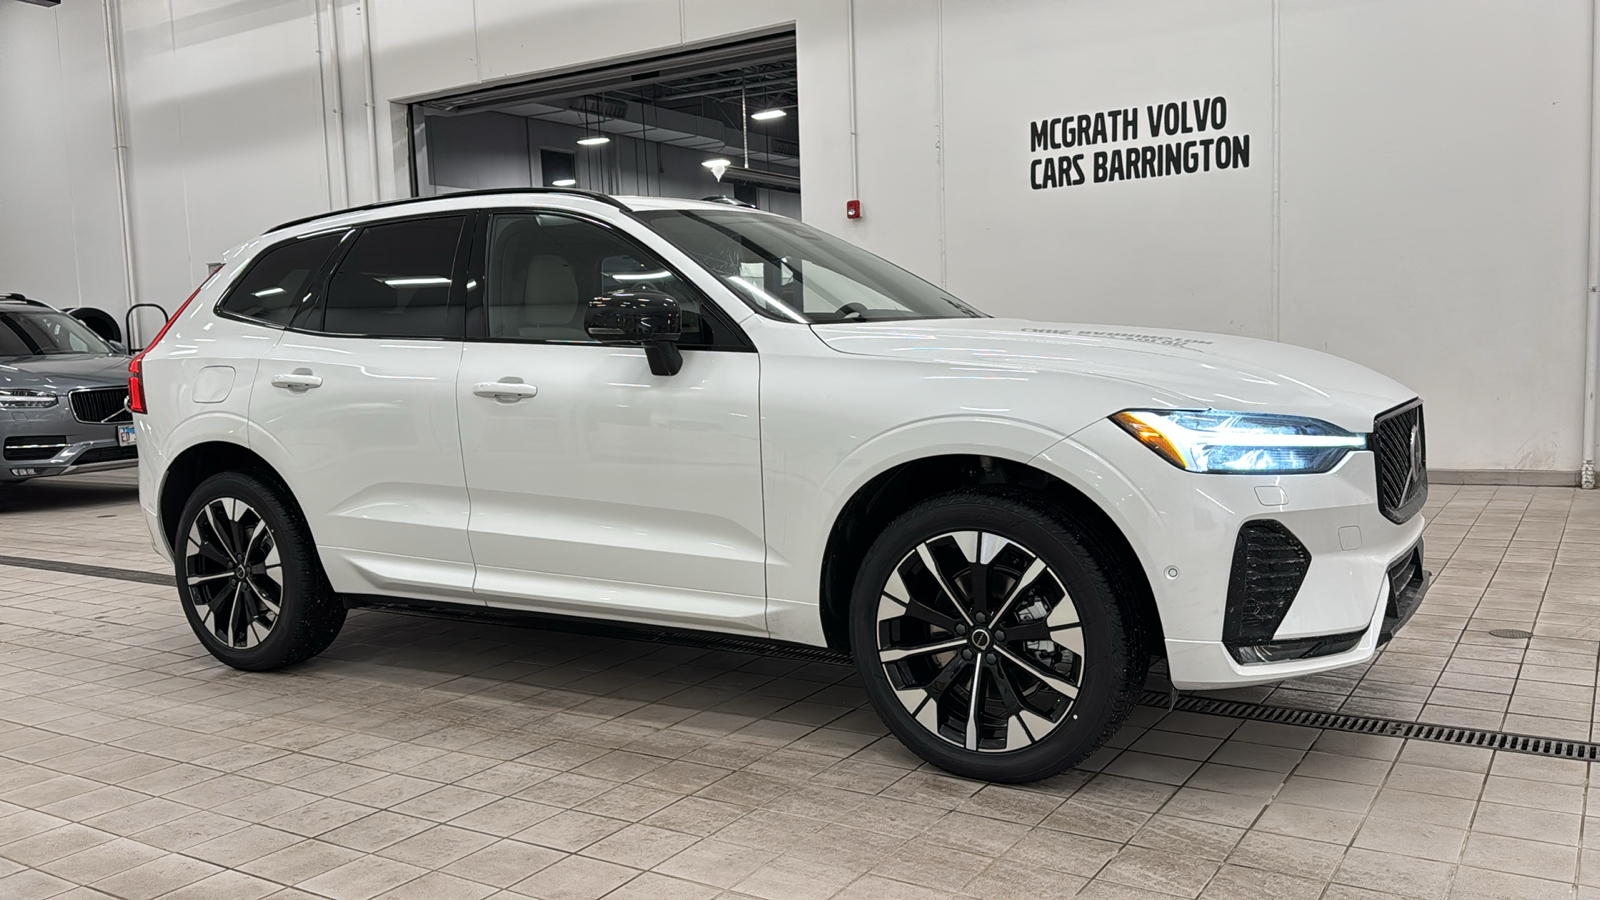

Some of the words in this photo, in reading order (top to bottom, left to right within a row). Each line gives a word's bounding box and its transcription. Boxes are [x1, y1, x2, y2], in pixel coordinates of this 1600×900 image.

[1030, 108, 1138, 153] MCGRATH
[1146, 96, 1227, 138] VOLVO
[1030, 154, 1085, 190] CARS
[1093, 134, 1250, 184] BARRINGTON
